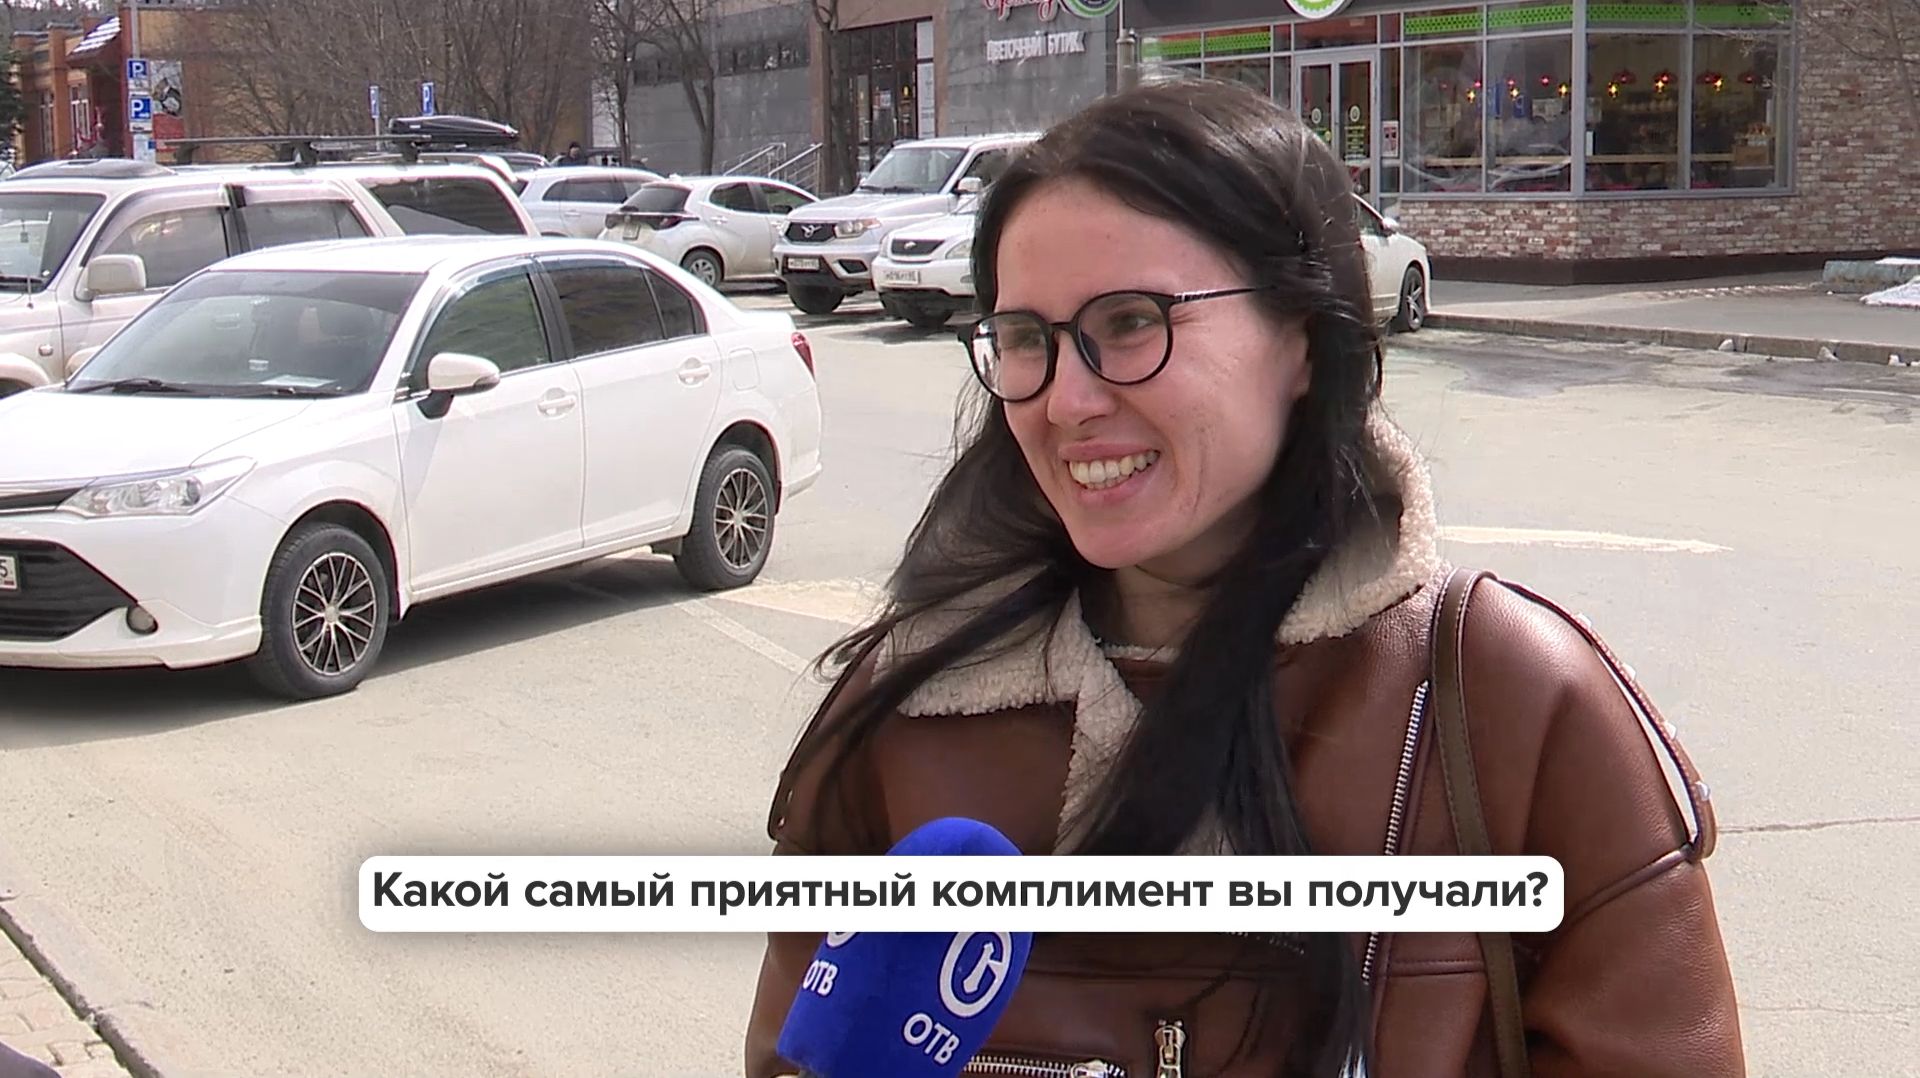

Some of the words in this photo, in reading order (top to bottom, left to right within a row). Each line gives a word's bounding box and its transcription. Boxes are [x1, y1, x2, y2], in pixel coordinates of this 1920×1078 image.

[1047, 30, 1086, 54] БУТИК
[802, 959, 838, 996] ОТВ
[903, 1012, 960, 1065] ОТВ
